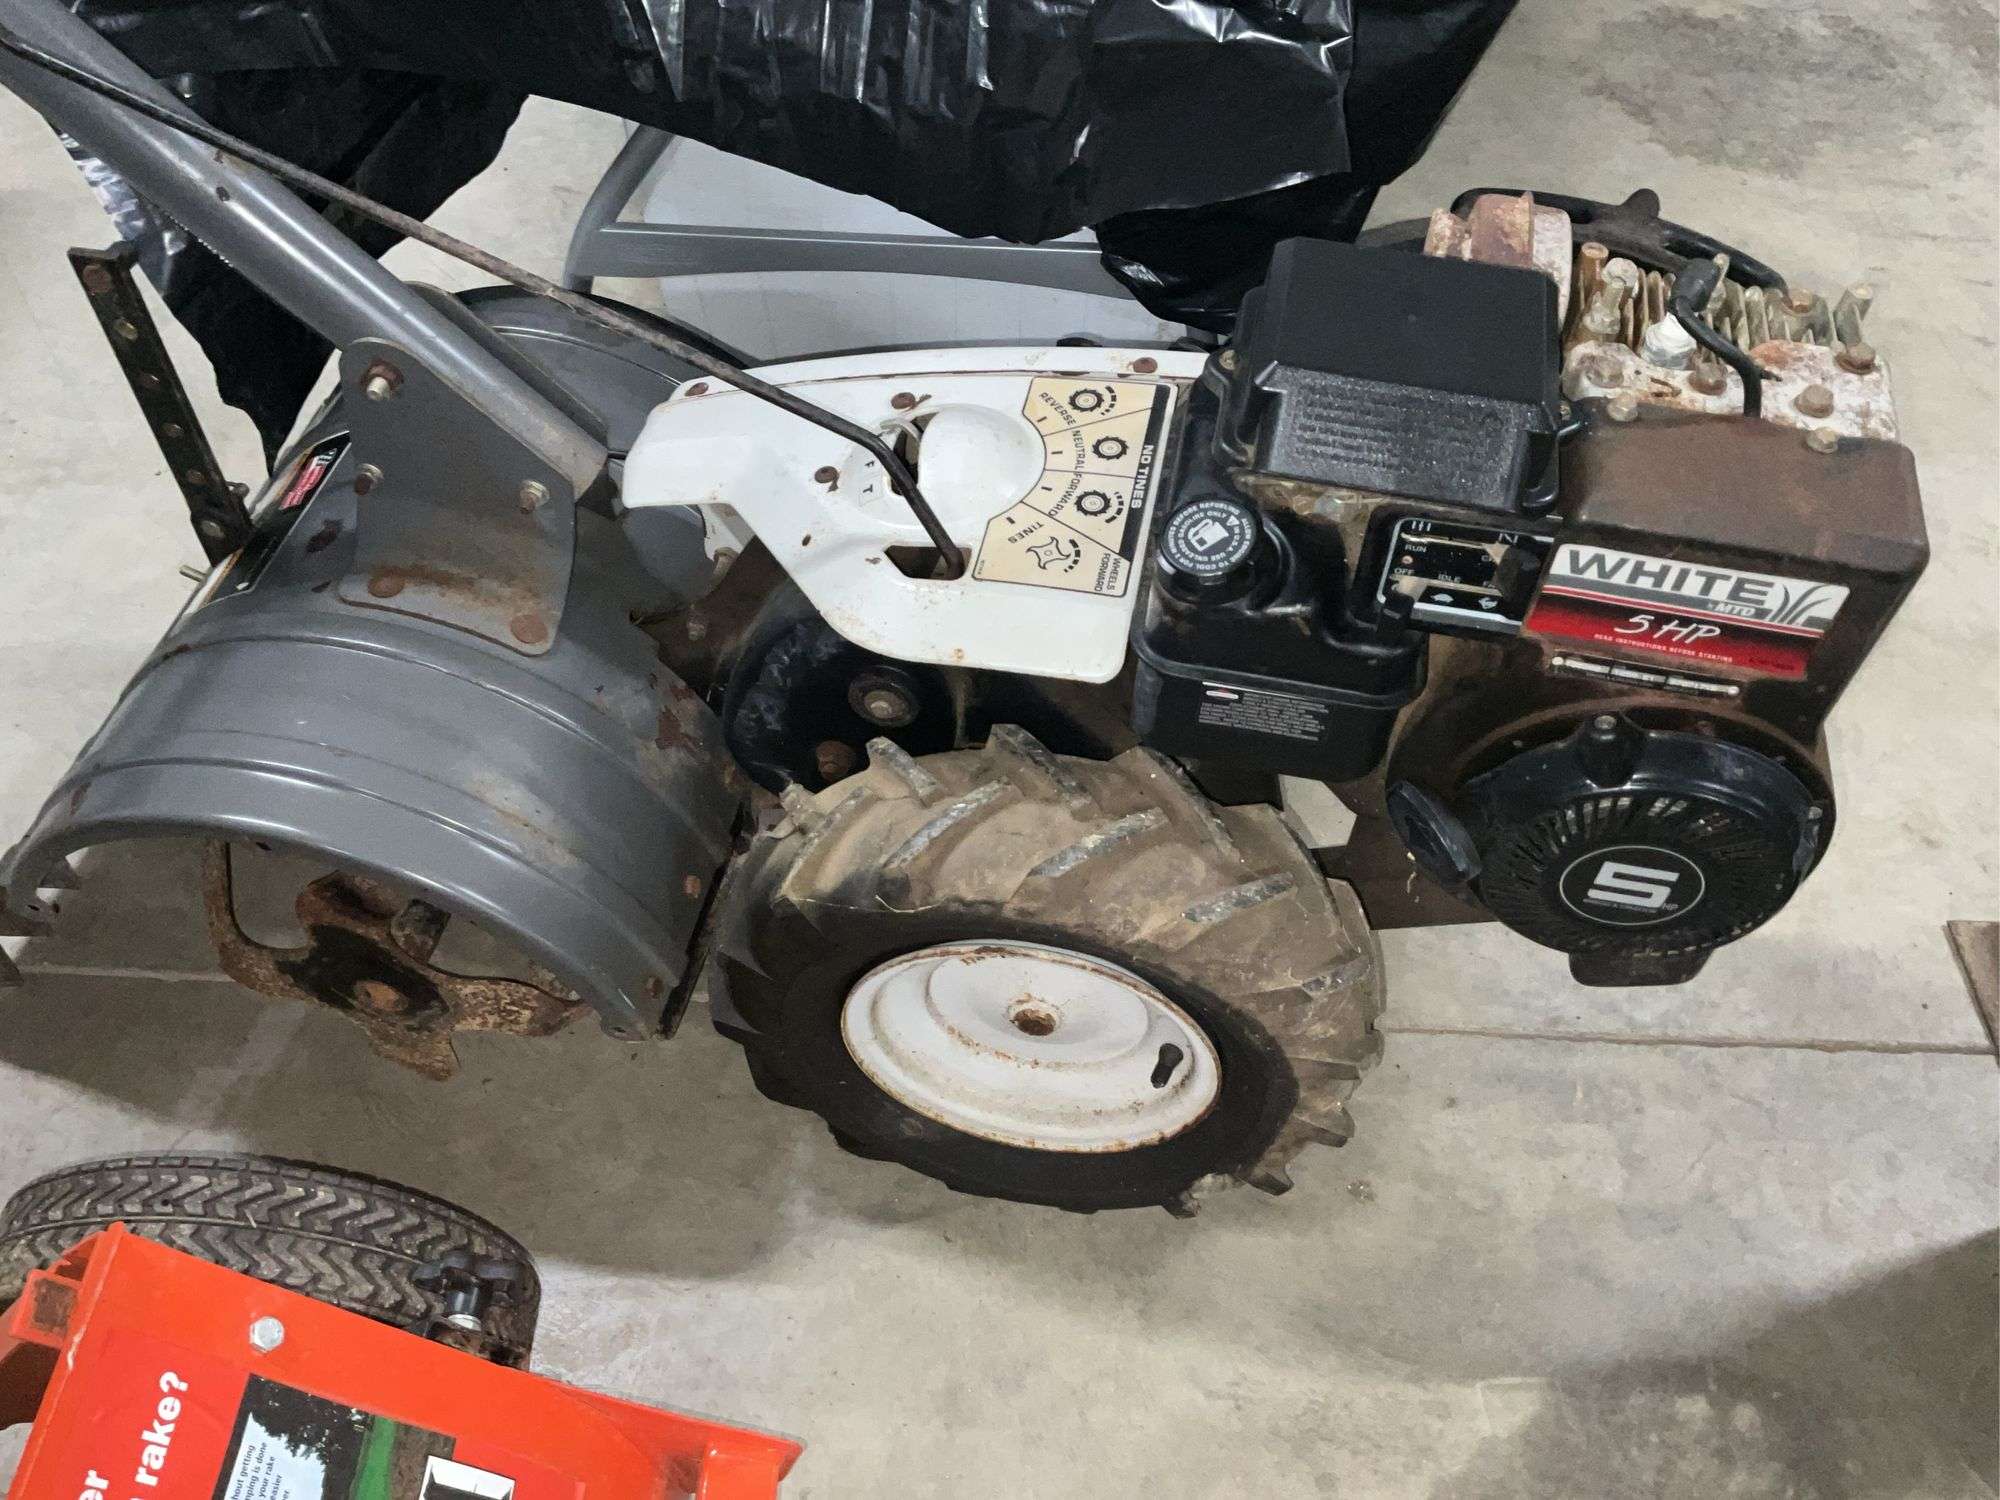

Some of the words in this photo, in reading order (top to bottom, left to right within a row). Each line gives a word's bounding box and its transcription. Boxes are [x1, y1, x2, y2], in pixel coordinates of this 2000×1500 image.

[1038, 392, 1077, 425] REVERSE
[1072, 429, 1086, 476] NEUTRAL
[1139, 444, 1154, 465] NO
[1048, 472, 1083, 518] FORWARD
[1131, 466, 1150, 509] TINES
[1173, 505, 1198, 526] BEFORE
[1199, 502, 1241, 516] REFUELING
[1007, 521, 1044, 544] TINES
[1404, 544, 1428, 553] RUN
[1095, 553, 1111, 592] FORWARD
[1107, 558, 1121, 590] WHEELS
[1196, 563, 1217, 571] COOL
[1218, 560, 1229, 568] TO
[1394, 567, 1415, 575] OFF
[1438, 573, 1461, 583] IDLE
[1568, 548, 1776, 606] WHITE
[1714, 602, 1757, 617] MTD
[1613, 613, 1655, 634] 5
[1653, 619, 1721, 644] HP
[1615, 637, 1667, 651] INSTRUCTIONS
[1669, 645, 1696, 656] BEFORE
[1698, 651, 1733, 663] STARTING
[1587, 861, 1680, 908] 5
[134, 1371, 189, 1487] rake?
[240, 1445, 255, 1477] getting
[255, 1442, 267, 1464] done
[259, 1478, 269, 1498] your
[265, 1456, 275, 1475] rake
